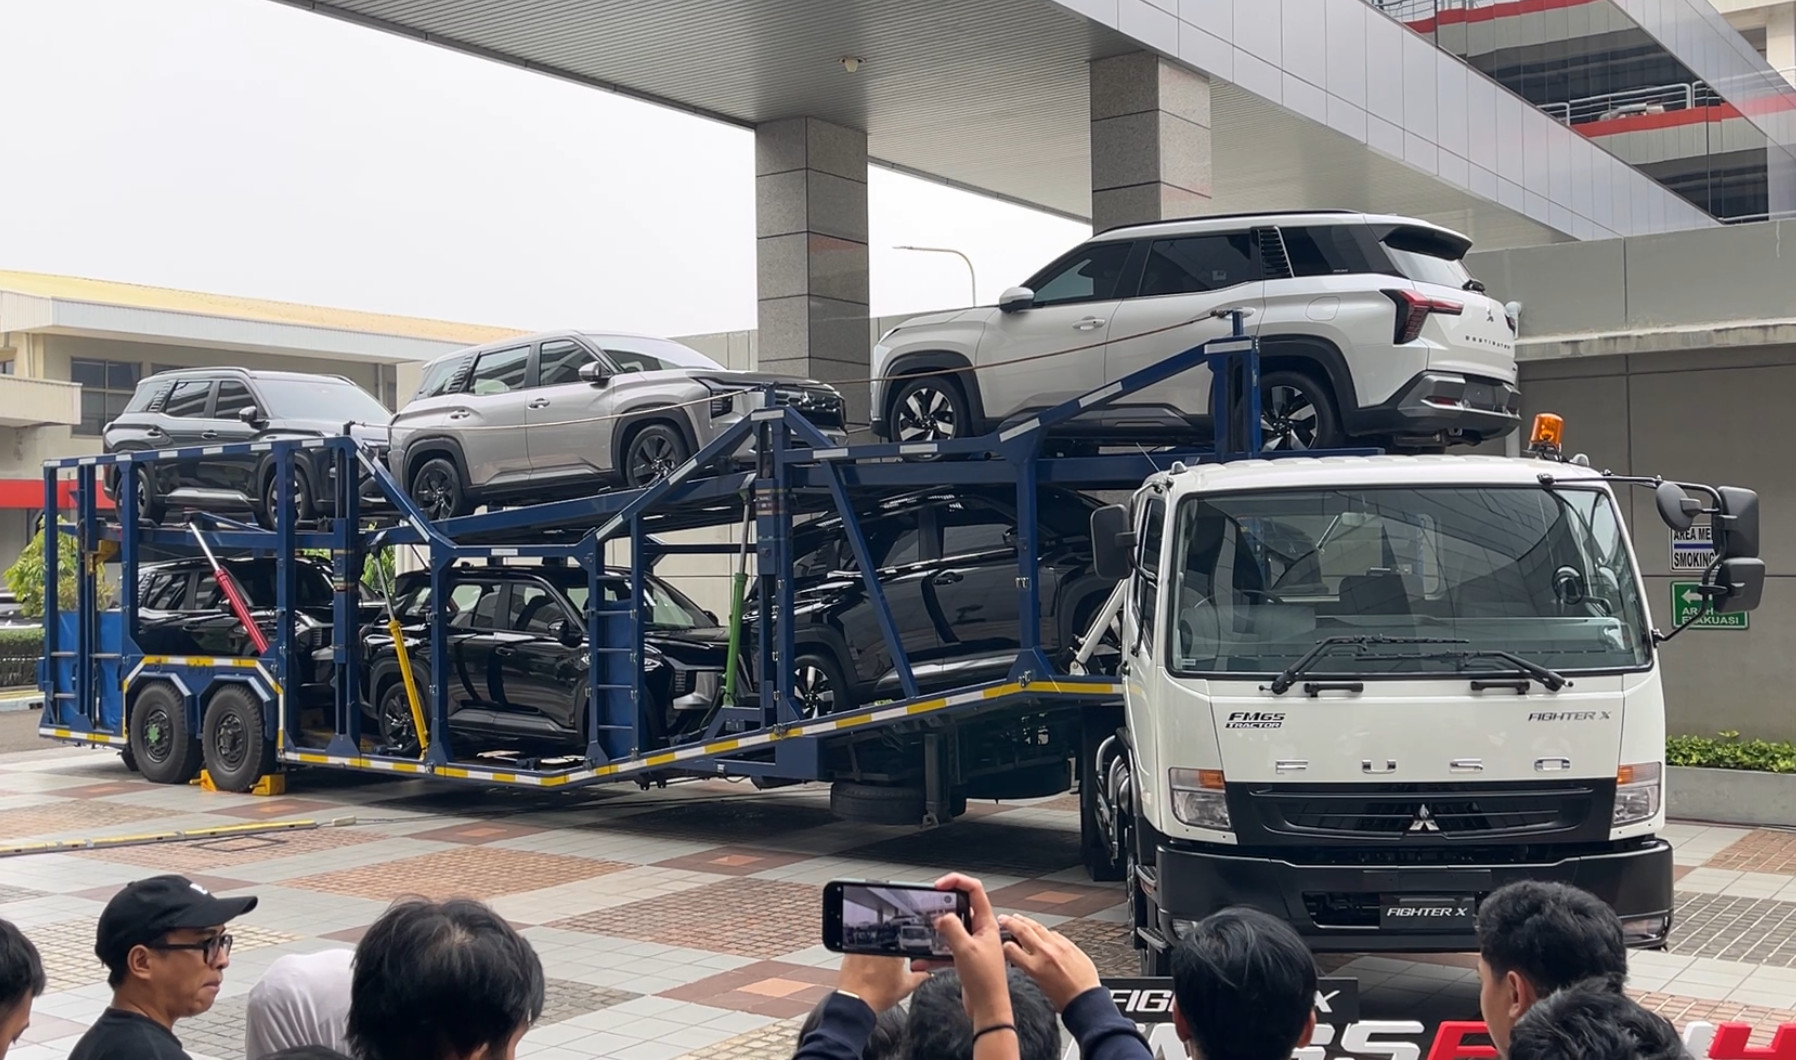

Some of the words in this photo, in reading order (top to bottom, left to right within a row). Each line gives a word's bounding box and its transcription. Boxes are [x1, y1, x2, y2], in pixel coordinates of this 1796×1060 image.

[1674, 528, 1696, 540] AREA
[1698, 528, 1712, 540] ME
[1674, 552, 1715, 567] SMOKING
[1682, 607, 1714, 615] ARH
[1682, 616, 1739, 624] EAKUASI
[1528, 711, 1596, 721] FIGHTER
[1599, 710, 1612, 720] X
[1276, 757, 1570, 774] FUSO
[1386, 907, 1453, 917] FIGHTER
[1454, 907, 1468, 917] X
[1110, 989, 1176, 1012] FIG
